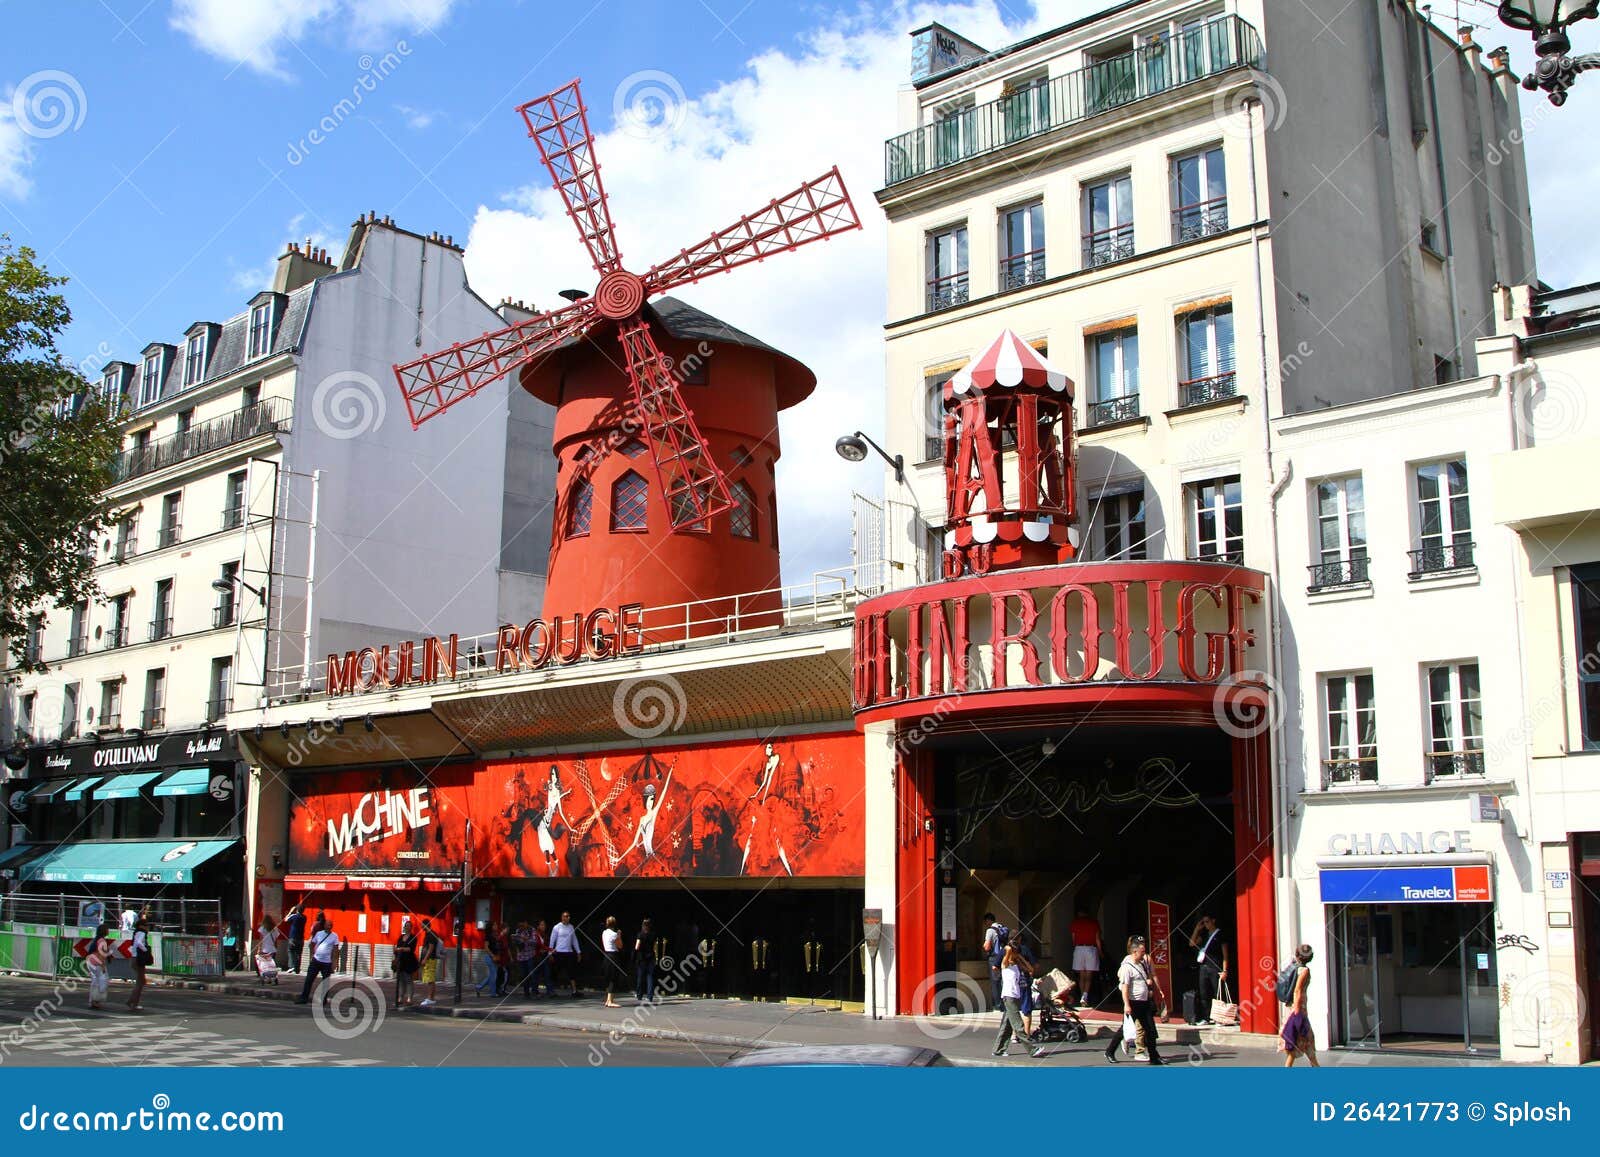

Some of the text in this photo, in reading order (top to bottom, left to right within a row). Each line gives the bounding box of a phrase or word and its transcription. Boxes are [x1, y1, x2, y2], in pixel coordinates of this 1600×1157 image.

[326, 602, 644, 697] MOULIN ROUGE
[989, 580, 1264, 687] ROUGE
[94, 744, 160, 766] O'SULLIVANS
[327, 786, 431, 858] MACHINE
[1327, 829, 1473, 856] CHANGE
[1400, 886, 1452, 899] Travelex
